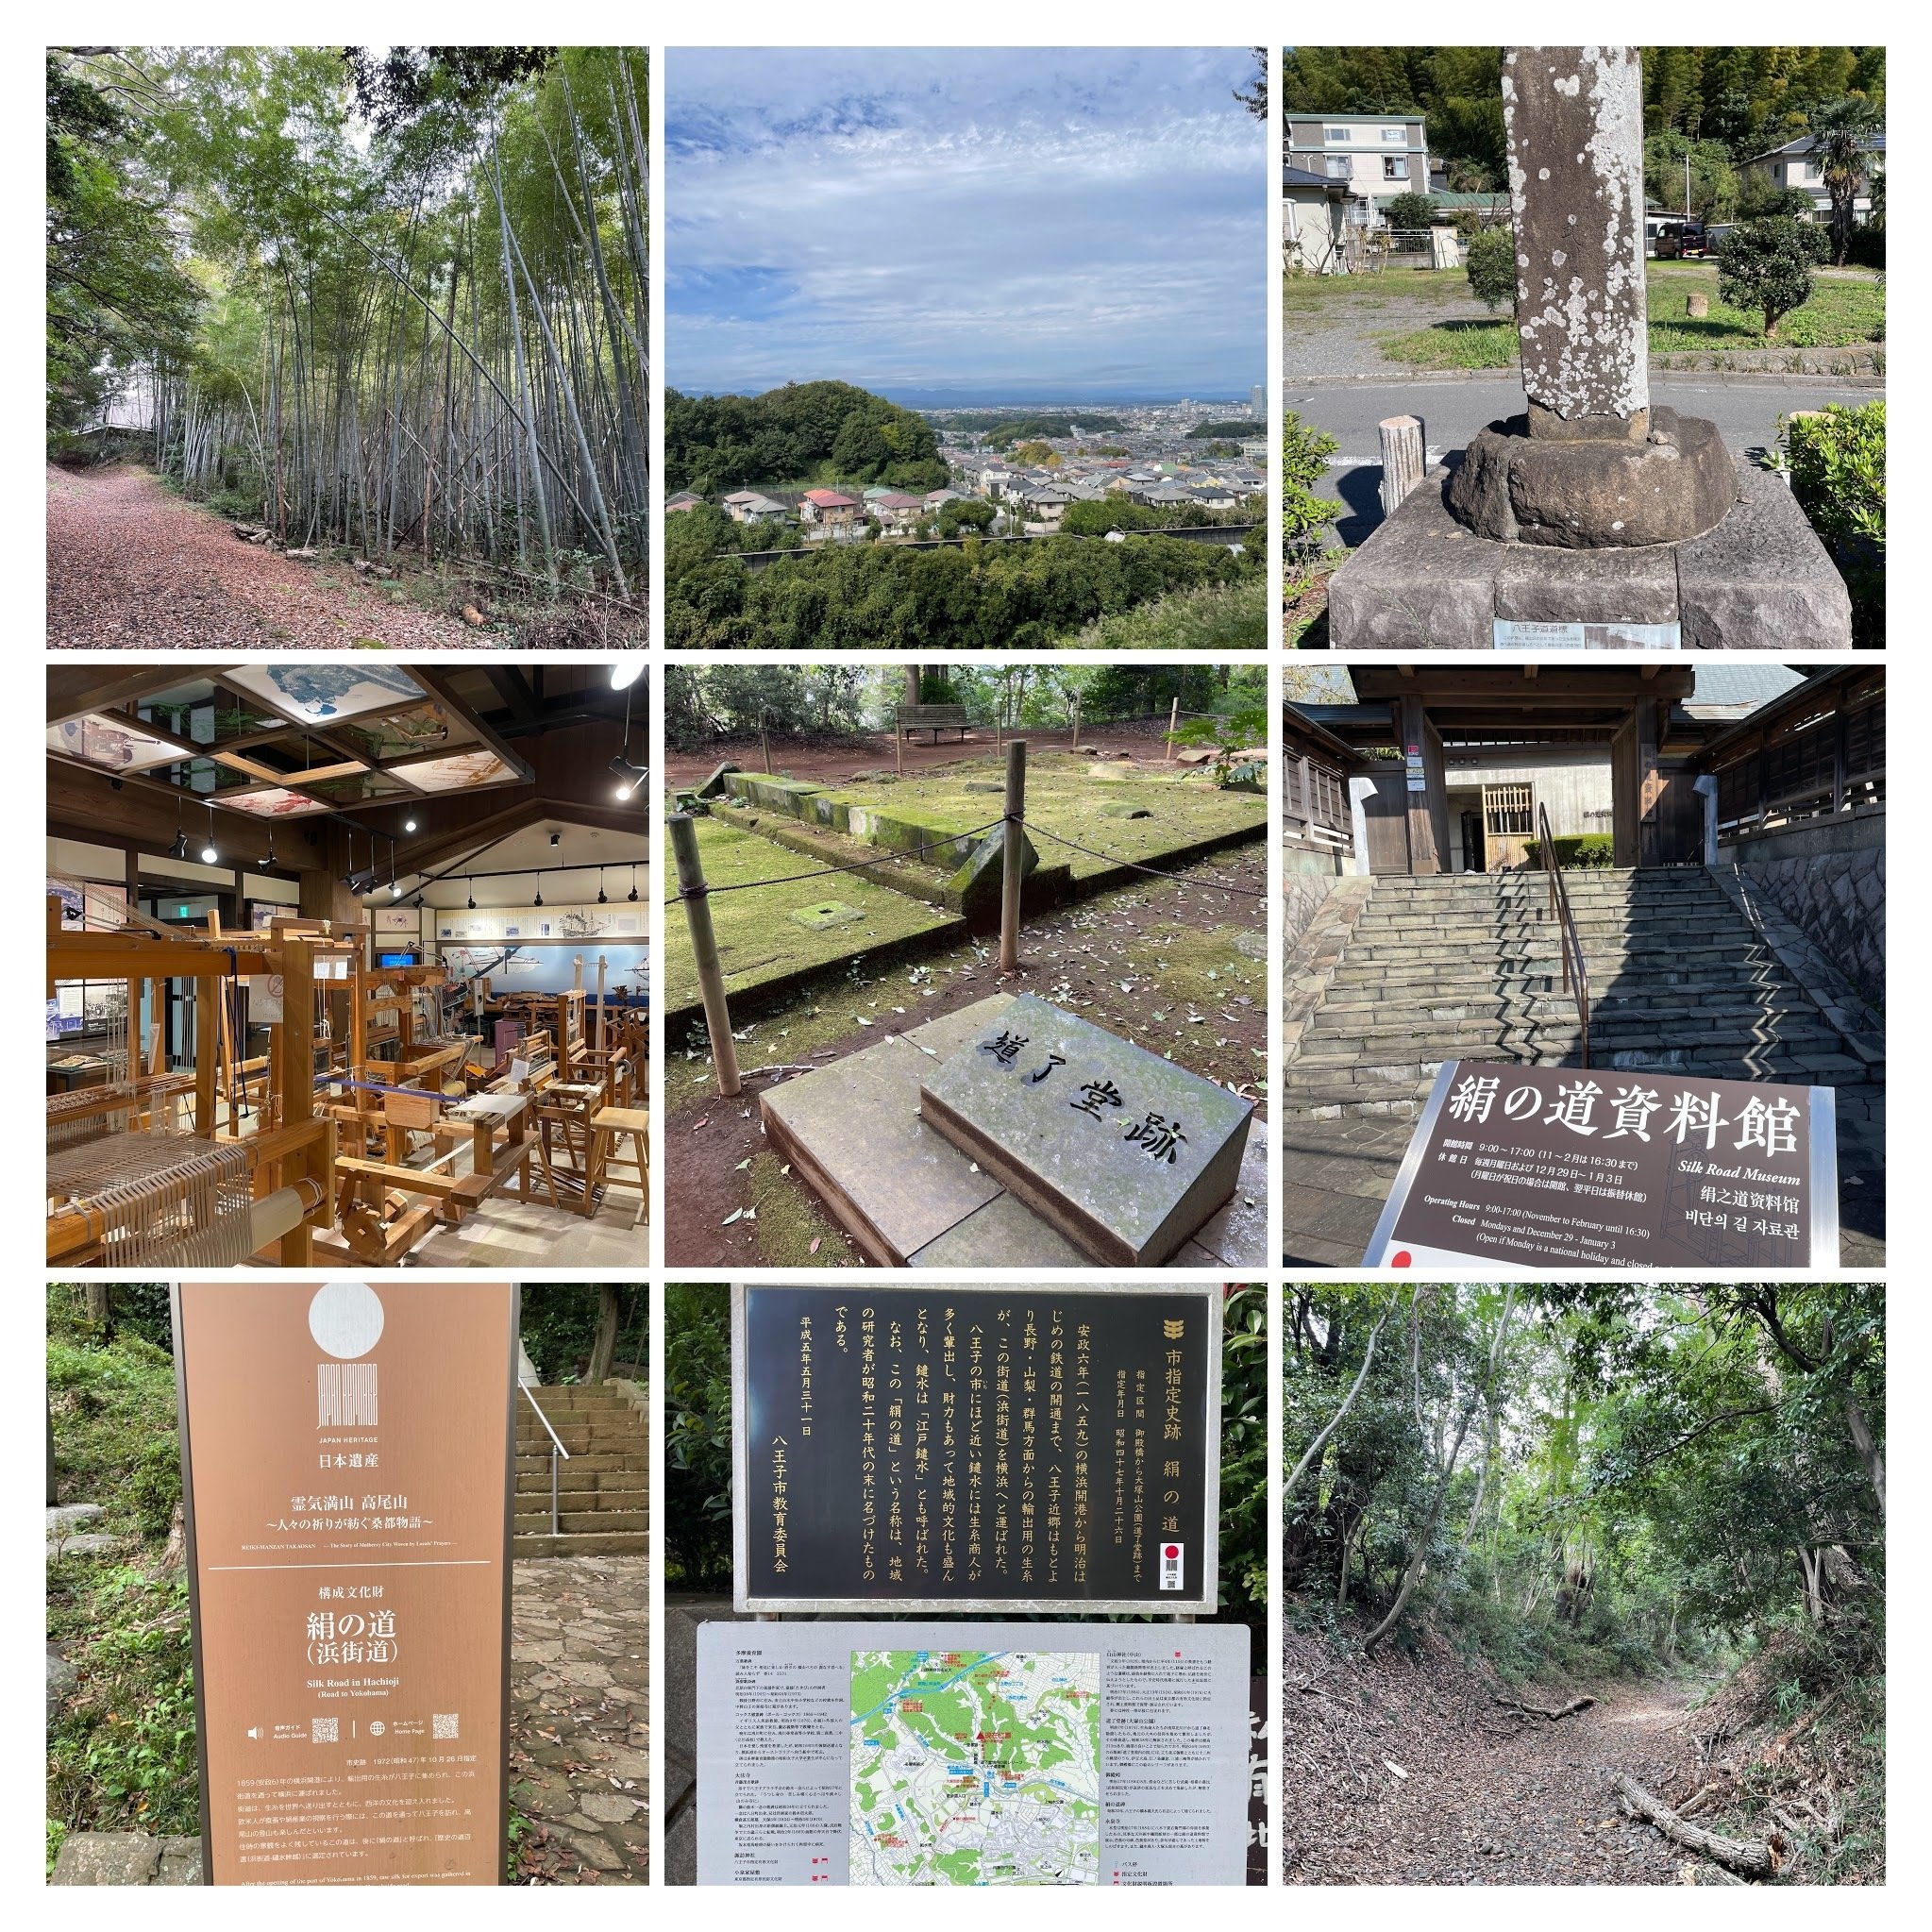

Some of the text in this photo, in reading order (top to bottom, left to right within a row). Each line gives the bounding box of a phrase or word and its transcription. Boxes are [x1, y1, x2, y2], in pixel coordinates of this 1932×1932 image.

[983, 1030, 1188, 1165] 道了堂跡
[1448, 1074, 1802, 1158] 絹の道資料館
[1442, 1138, 1473, 1151] 開館時間
[1678, 1160, 1801, 1185] Silk Road Museum
[1424, 1194, 1457, 1208] Operating
[1459, 1200, 1480, 1211] Hours
[1485, 1204, 1521, 1218] 9:00-17:00
[1521, 1210, 1561, 1224] (November
[1571, 1218, 1604, 1232] February
[1605, 1225, 1623, 1235] until
[1625, 1226, 1650, 1239] 16:30)
[1701, 1185, 1800, 1215] 绢之道资料馆
[1452, 1214, 1616, 1250] Closed Mondays and December 29 January 3
[1685, 1209, 1800, 1240] 비단의 길 자료관
[1476, 1232, 1498, 1244] (Open
[1499, 1236, 1506, 1245] if
[1505, 1237, 1536, 1252] Monday
[1536, 1241, 1542, 1252] is
[1550, 1246, 1580, 1258] national
[1580, 1250, 1609, 1265] holiday
[1610, 1258, 1626, 1267] and
[835, 1306, 848, 1353] である。
[799, 1317, 814, 1436] 平成五年五月三十一日
[1135, 1369, 1146, 1419] 指定区間
[1114, 1369, 1126, 1544] 指定年月日 昭和四十七年十月二十六日
[1162, 1349, 1183, 1533] 市指定史跡 絹の道
[319, 1453, 378, 1469] 日本遺産
[291, 1494, 408, 1512] 霊気満山 高尾山
[771, 1435, 789, 1573] 八王子市教育委員会
[318, 1586, 384, 1600] 構成文化財
[306, 1609, 396, 1641] 絹の道
[307, 1639, 398, 1665] （浜街道）
[307, 1679, 325, 1688] Silk
[327, 1679, 349, 1688] Road
[363, 1677, 399, 1688] Hachioji
